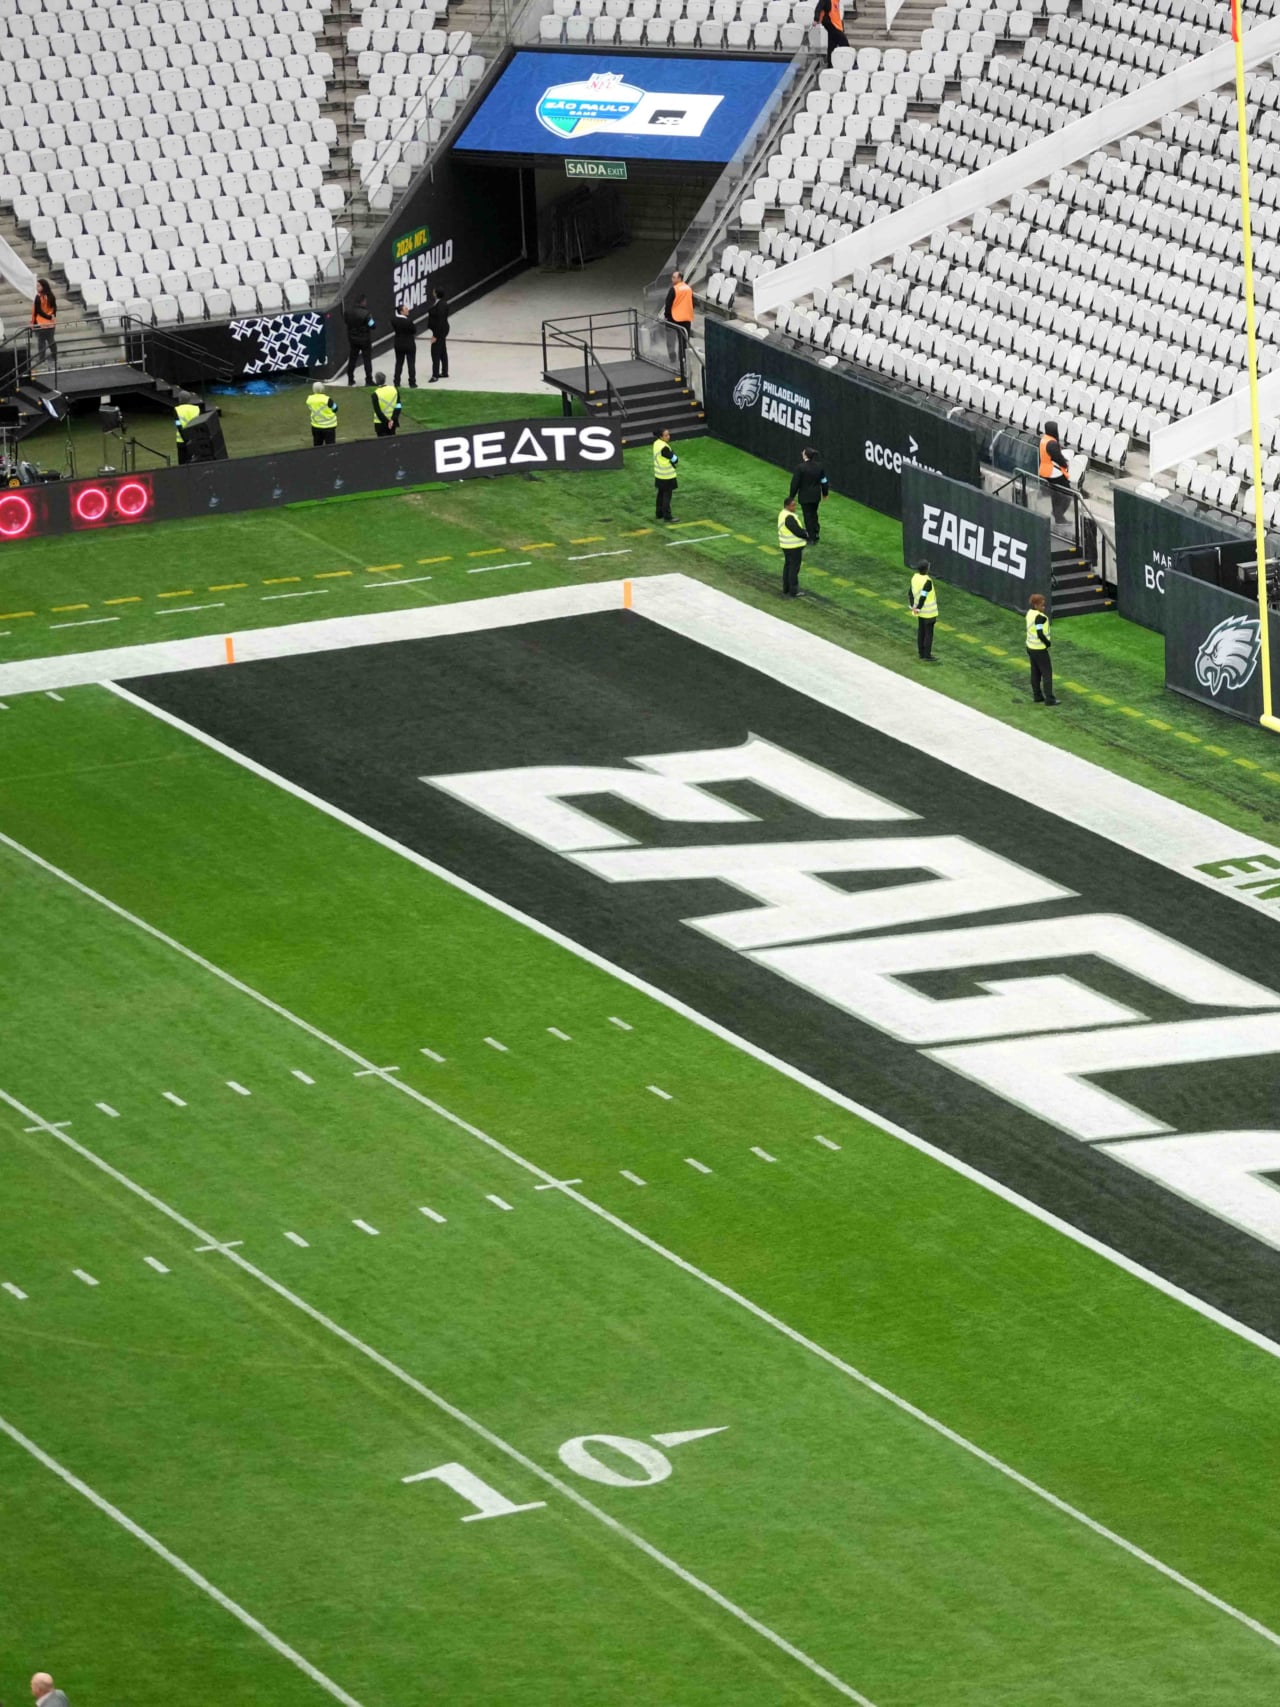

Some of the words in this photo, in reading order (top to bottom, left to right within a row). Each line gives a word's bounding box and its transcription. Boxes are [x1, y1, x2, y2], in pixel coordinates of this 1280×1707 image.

[544, 100, 577, 110] SÃO
[579, 103, 631, 112] PAULO
[568, 162, 607, 175] SAÍDA
[607, 167, 625, 175] EXIT
[396, 236, 413, 258] 2024
[414, 229, 428, 248] NFL
[393, 254, 416, 293] SÃO
[417, 238, 453, 280] PAULO
[762, 380, 811, 411] PHILADELPHIA
[761, 396, 812, 437] EAGLES
[922, 503, 1028, 580] EAGLES
[401, 1433, 673, 1522] 10
